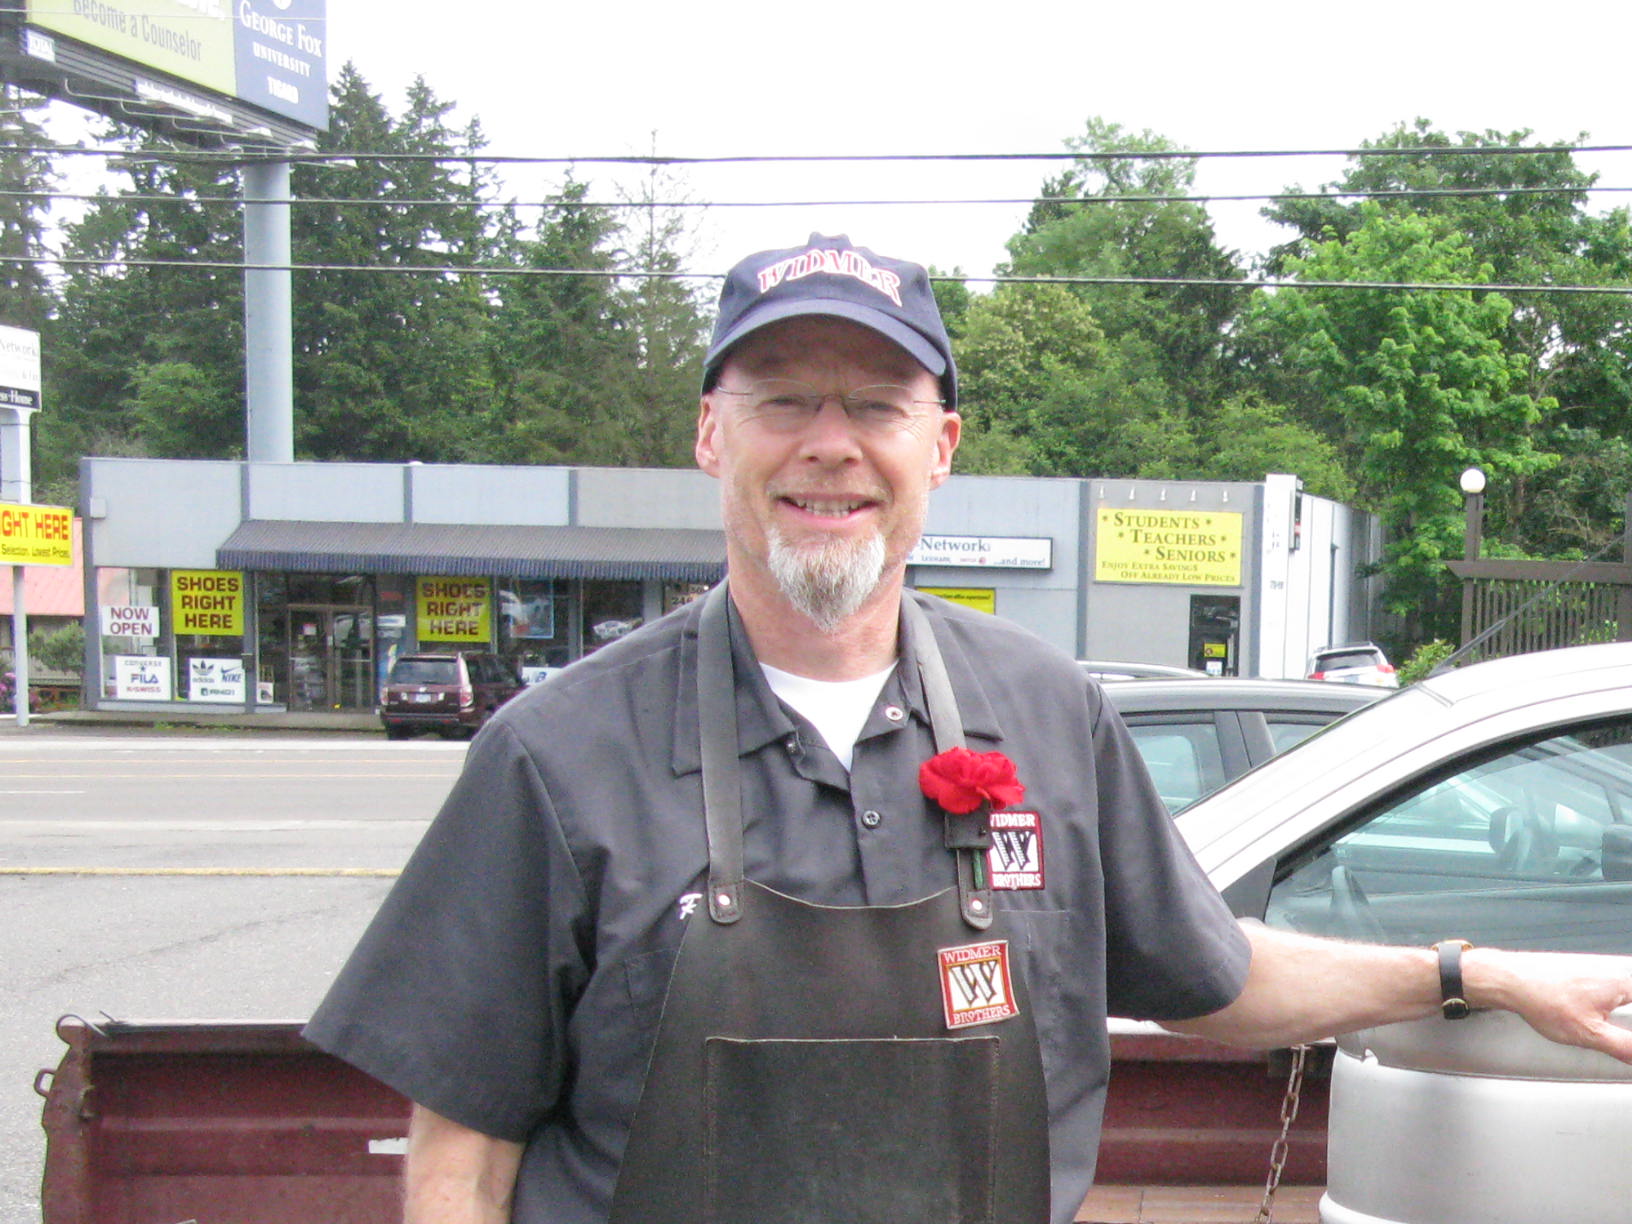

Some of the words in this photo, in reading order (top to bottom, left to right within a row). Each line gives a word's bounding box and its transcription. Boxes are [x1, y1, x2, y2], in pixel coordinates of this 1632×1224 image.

[240, 0, 295, 46] GEORGE
[298, 24, 323, 58] FOX
[130, 14, 139, 38] a
[142, 15, 202, 62] Counselor
[252, 41, 312, 77] UNIVERSITY
[757, 248, 903, 308] WIDMER
[35, 513, 69, 541] HERE
[1114, 511, 1200, 529] STUDENTS
[1130, 529, 1217, 546] TEACHERS
[1156, 546, 1226, 563] SENIORS
[177, 576, 239, 592] SHOES
[422, 582, 486, 598] SHOES
[181, 595, 236, 610] RIGHT
[426, 601, 483, 617] RIGHT
[110, 607, 149, 620] NOW
[184, 613, 233, 629] HERE
[110, 622, 152, 635] OPEN
[430, 620, 479, 636] HERE
[131, 673, 159, 684] FILA
[222, 673, 242, 683] NIKE
[992, 873, 1041, 887] BROTHERS
[944, 944, 1003, 964] WIDMER
[953, 1004, 1011, 1025] BROTHERS
